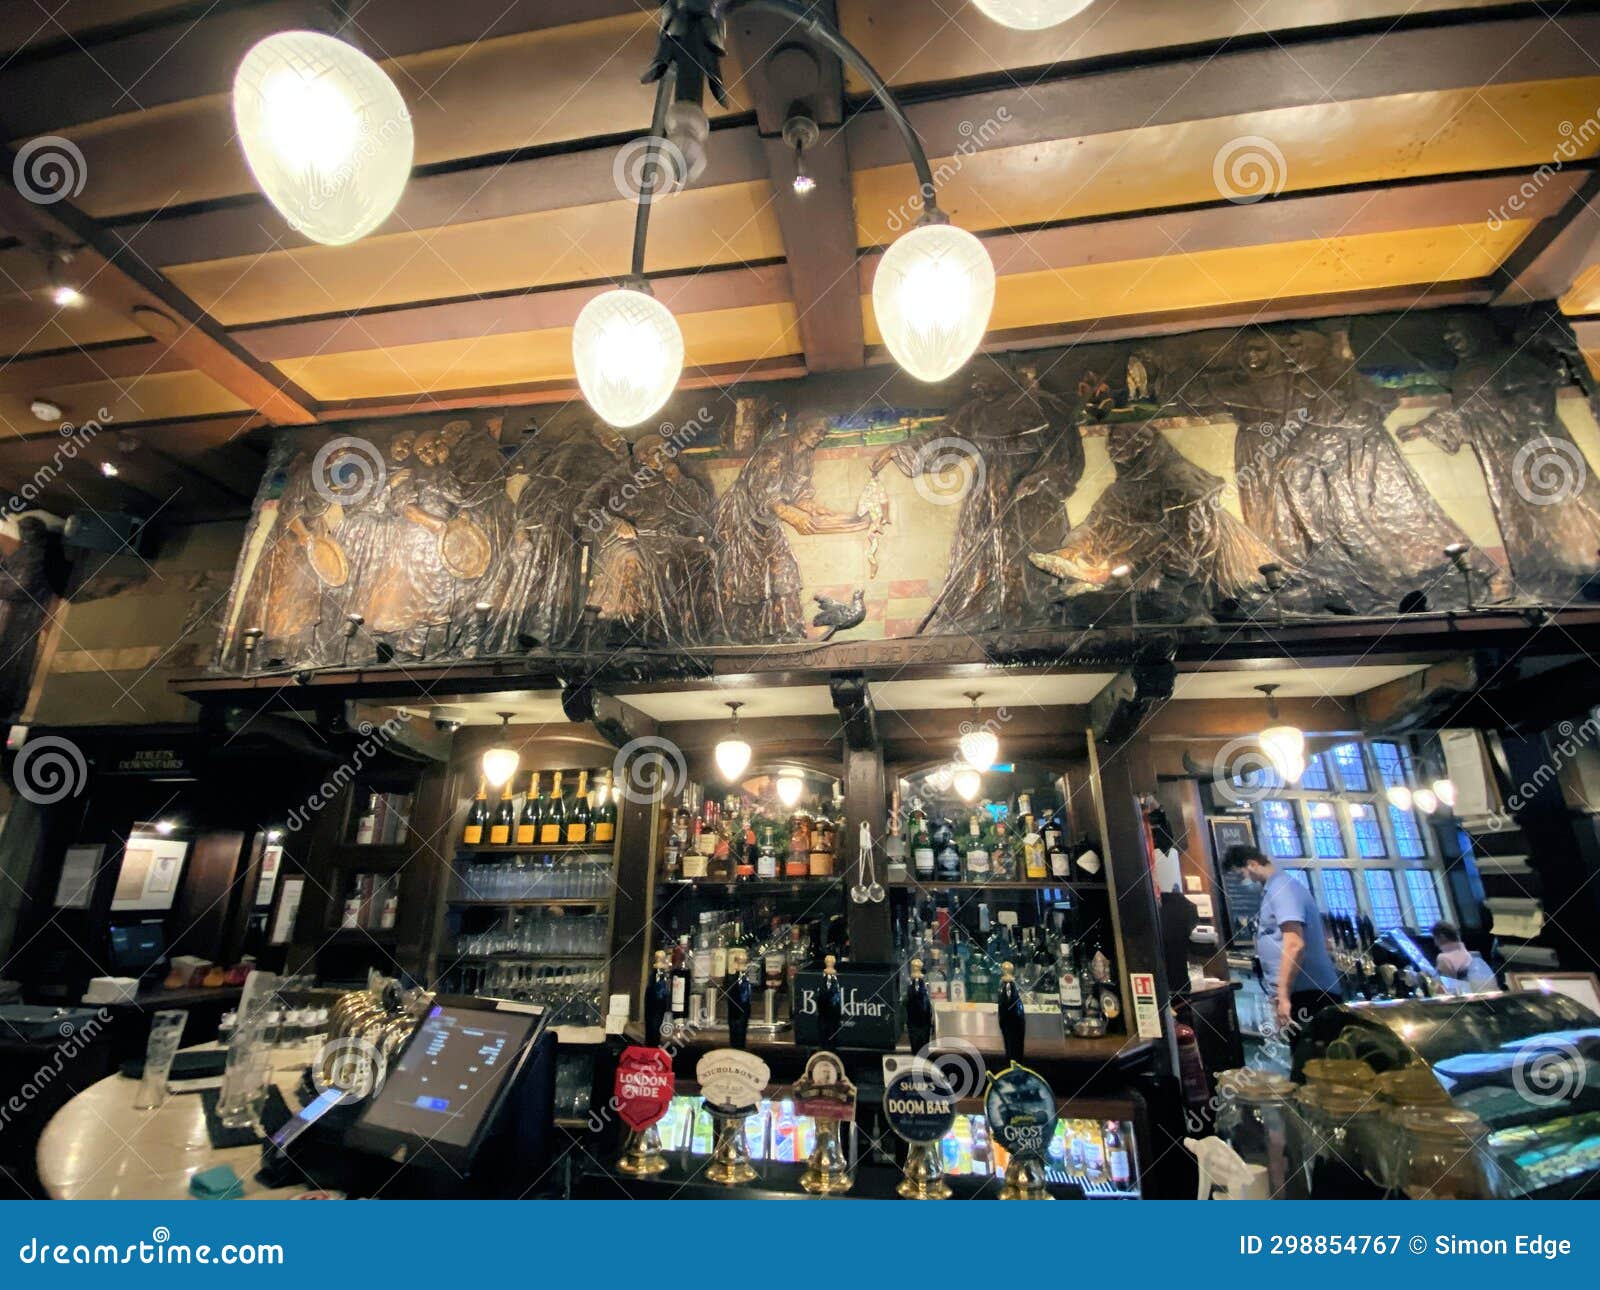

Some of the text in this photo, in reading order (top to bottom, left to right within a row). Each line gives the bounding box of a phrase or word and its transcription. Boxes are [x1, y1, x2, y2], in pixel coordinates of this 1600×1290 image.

[799, 987, 886, 1017] Bkfriar
[620, 1072, 668, 1087] LONDON
[889, 1099, 951, 1114] DOOM BAR
[1004, 1125, 1042, 1141] GHOST
[1017, 1137, 1043, 1151] SHIP
